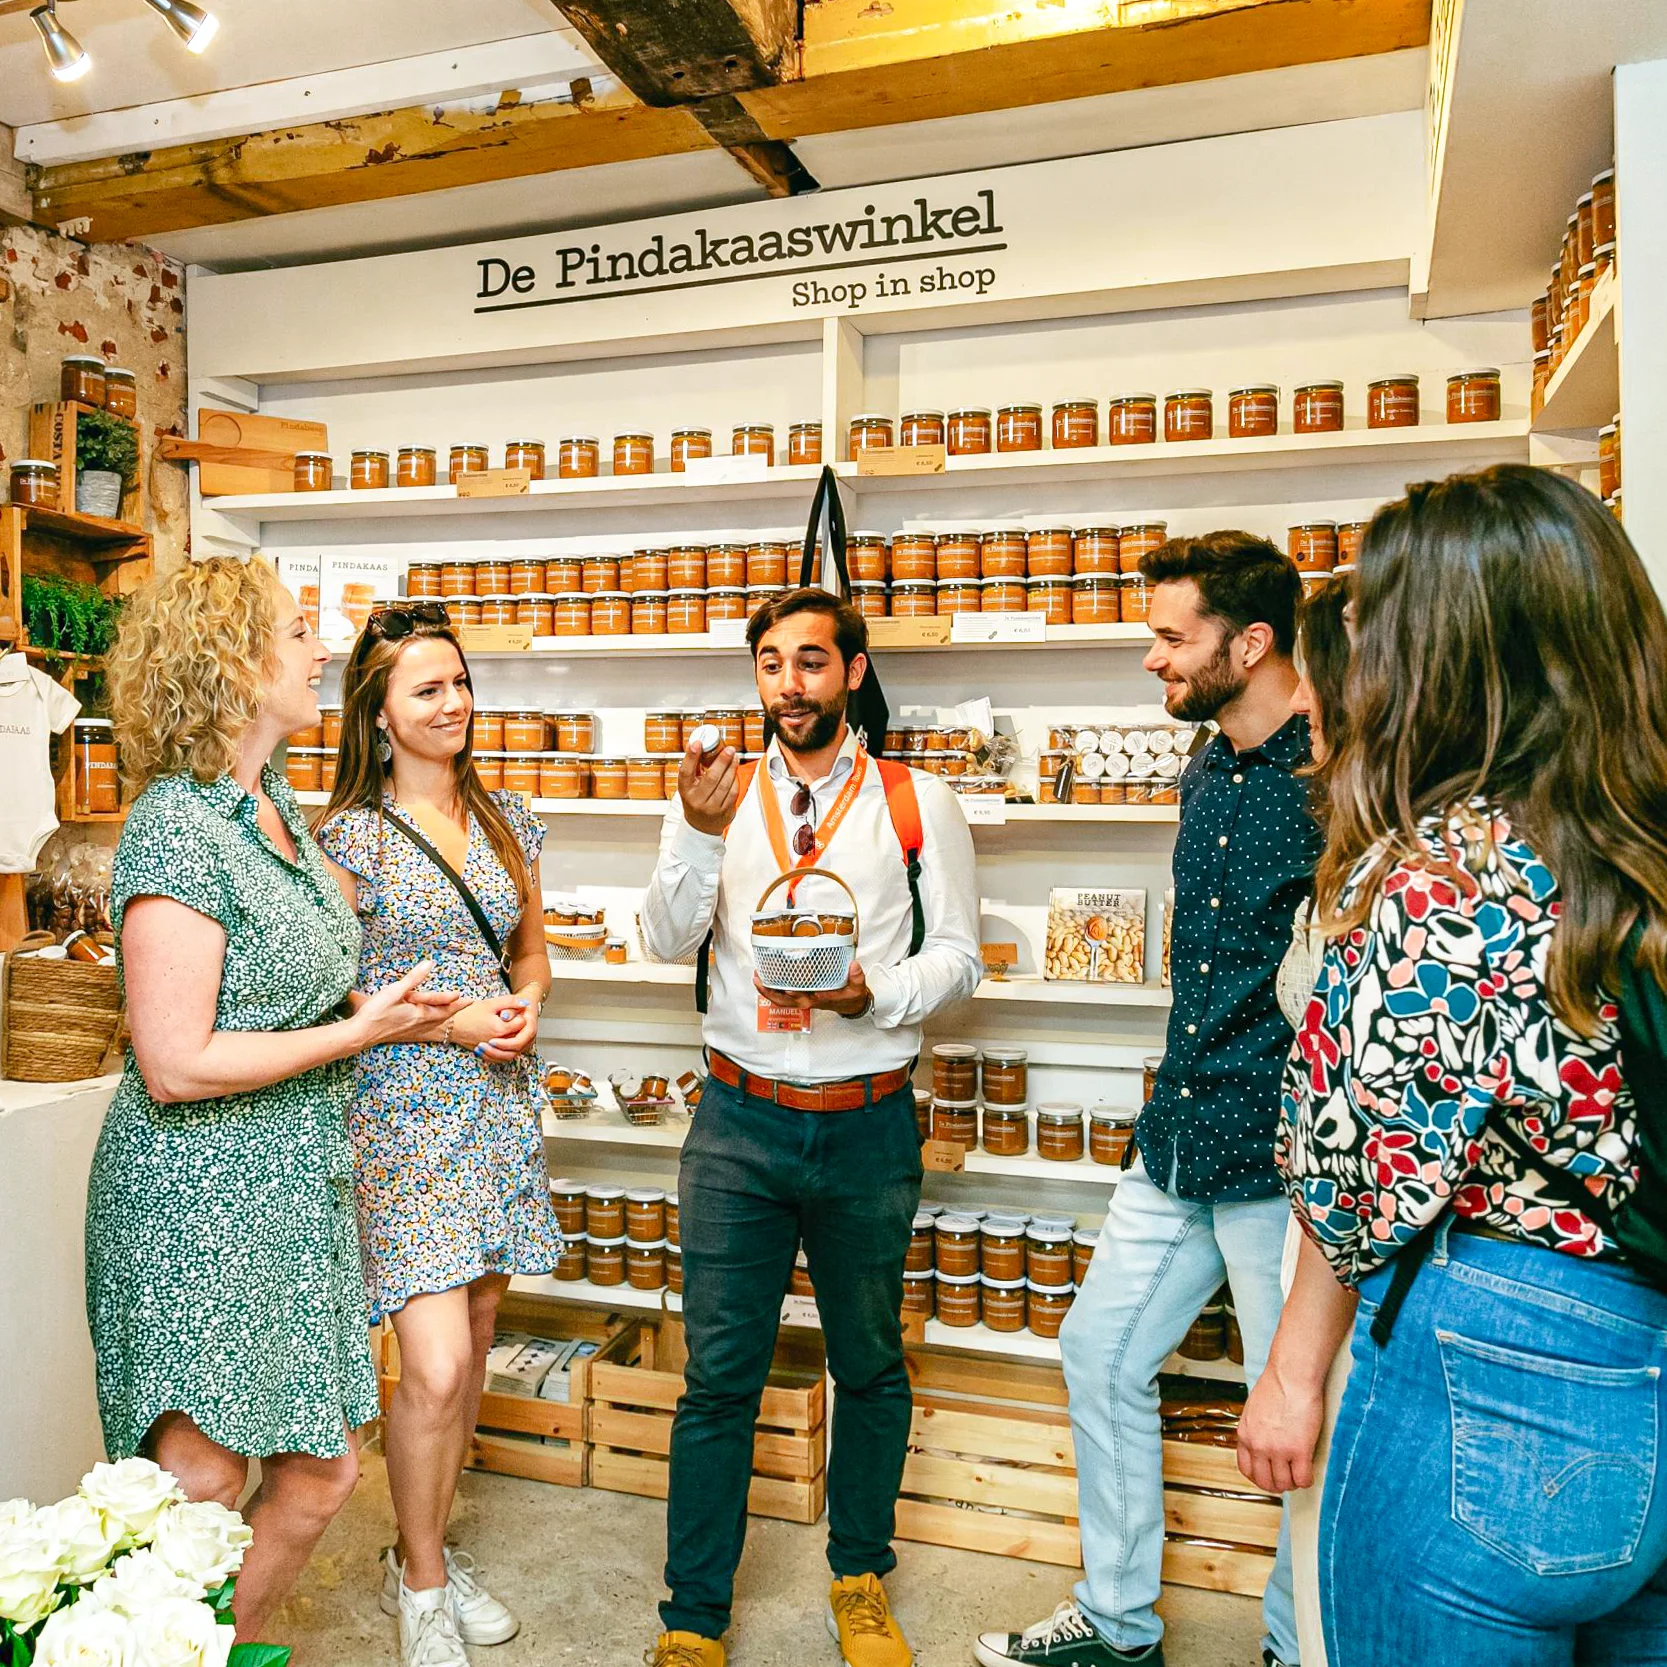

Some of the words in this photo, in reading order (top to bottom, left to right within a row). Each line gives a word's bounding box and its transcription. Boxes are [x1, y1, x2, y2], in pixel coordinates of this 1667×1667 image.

[477, 259, 535, 298] De
[555, 190, 1004, 289] Pindakaaswinkel
[791, 280, 868, 309] Shop
[875, 272, 911, 298] in
[919, 266, 997, 295] shop
[52, 412, 64, 460] COSTA
[331, 560, 389, 572] PINDAKAAS
[825, 785, 857, 829] Amsterdam
[851, 766, 863, 786] Tours
[1077, 893, 1122, 901] PEANUT
[768, 1008, 799, 1016] MANUEL
